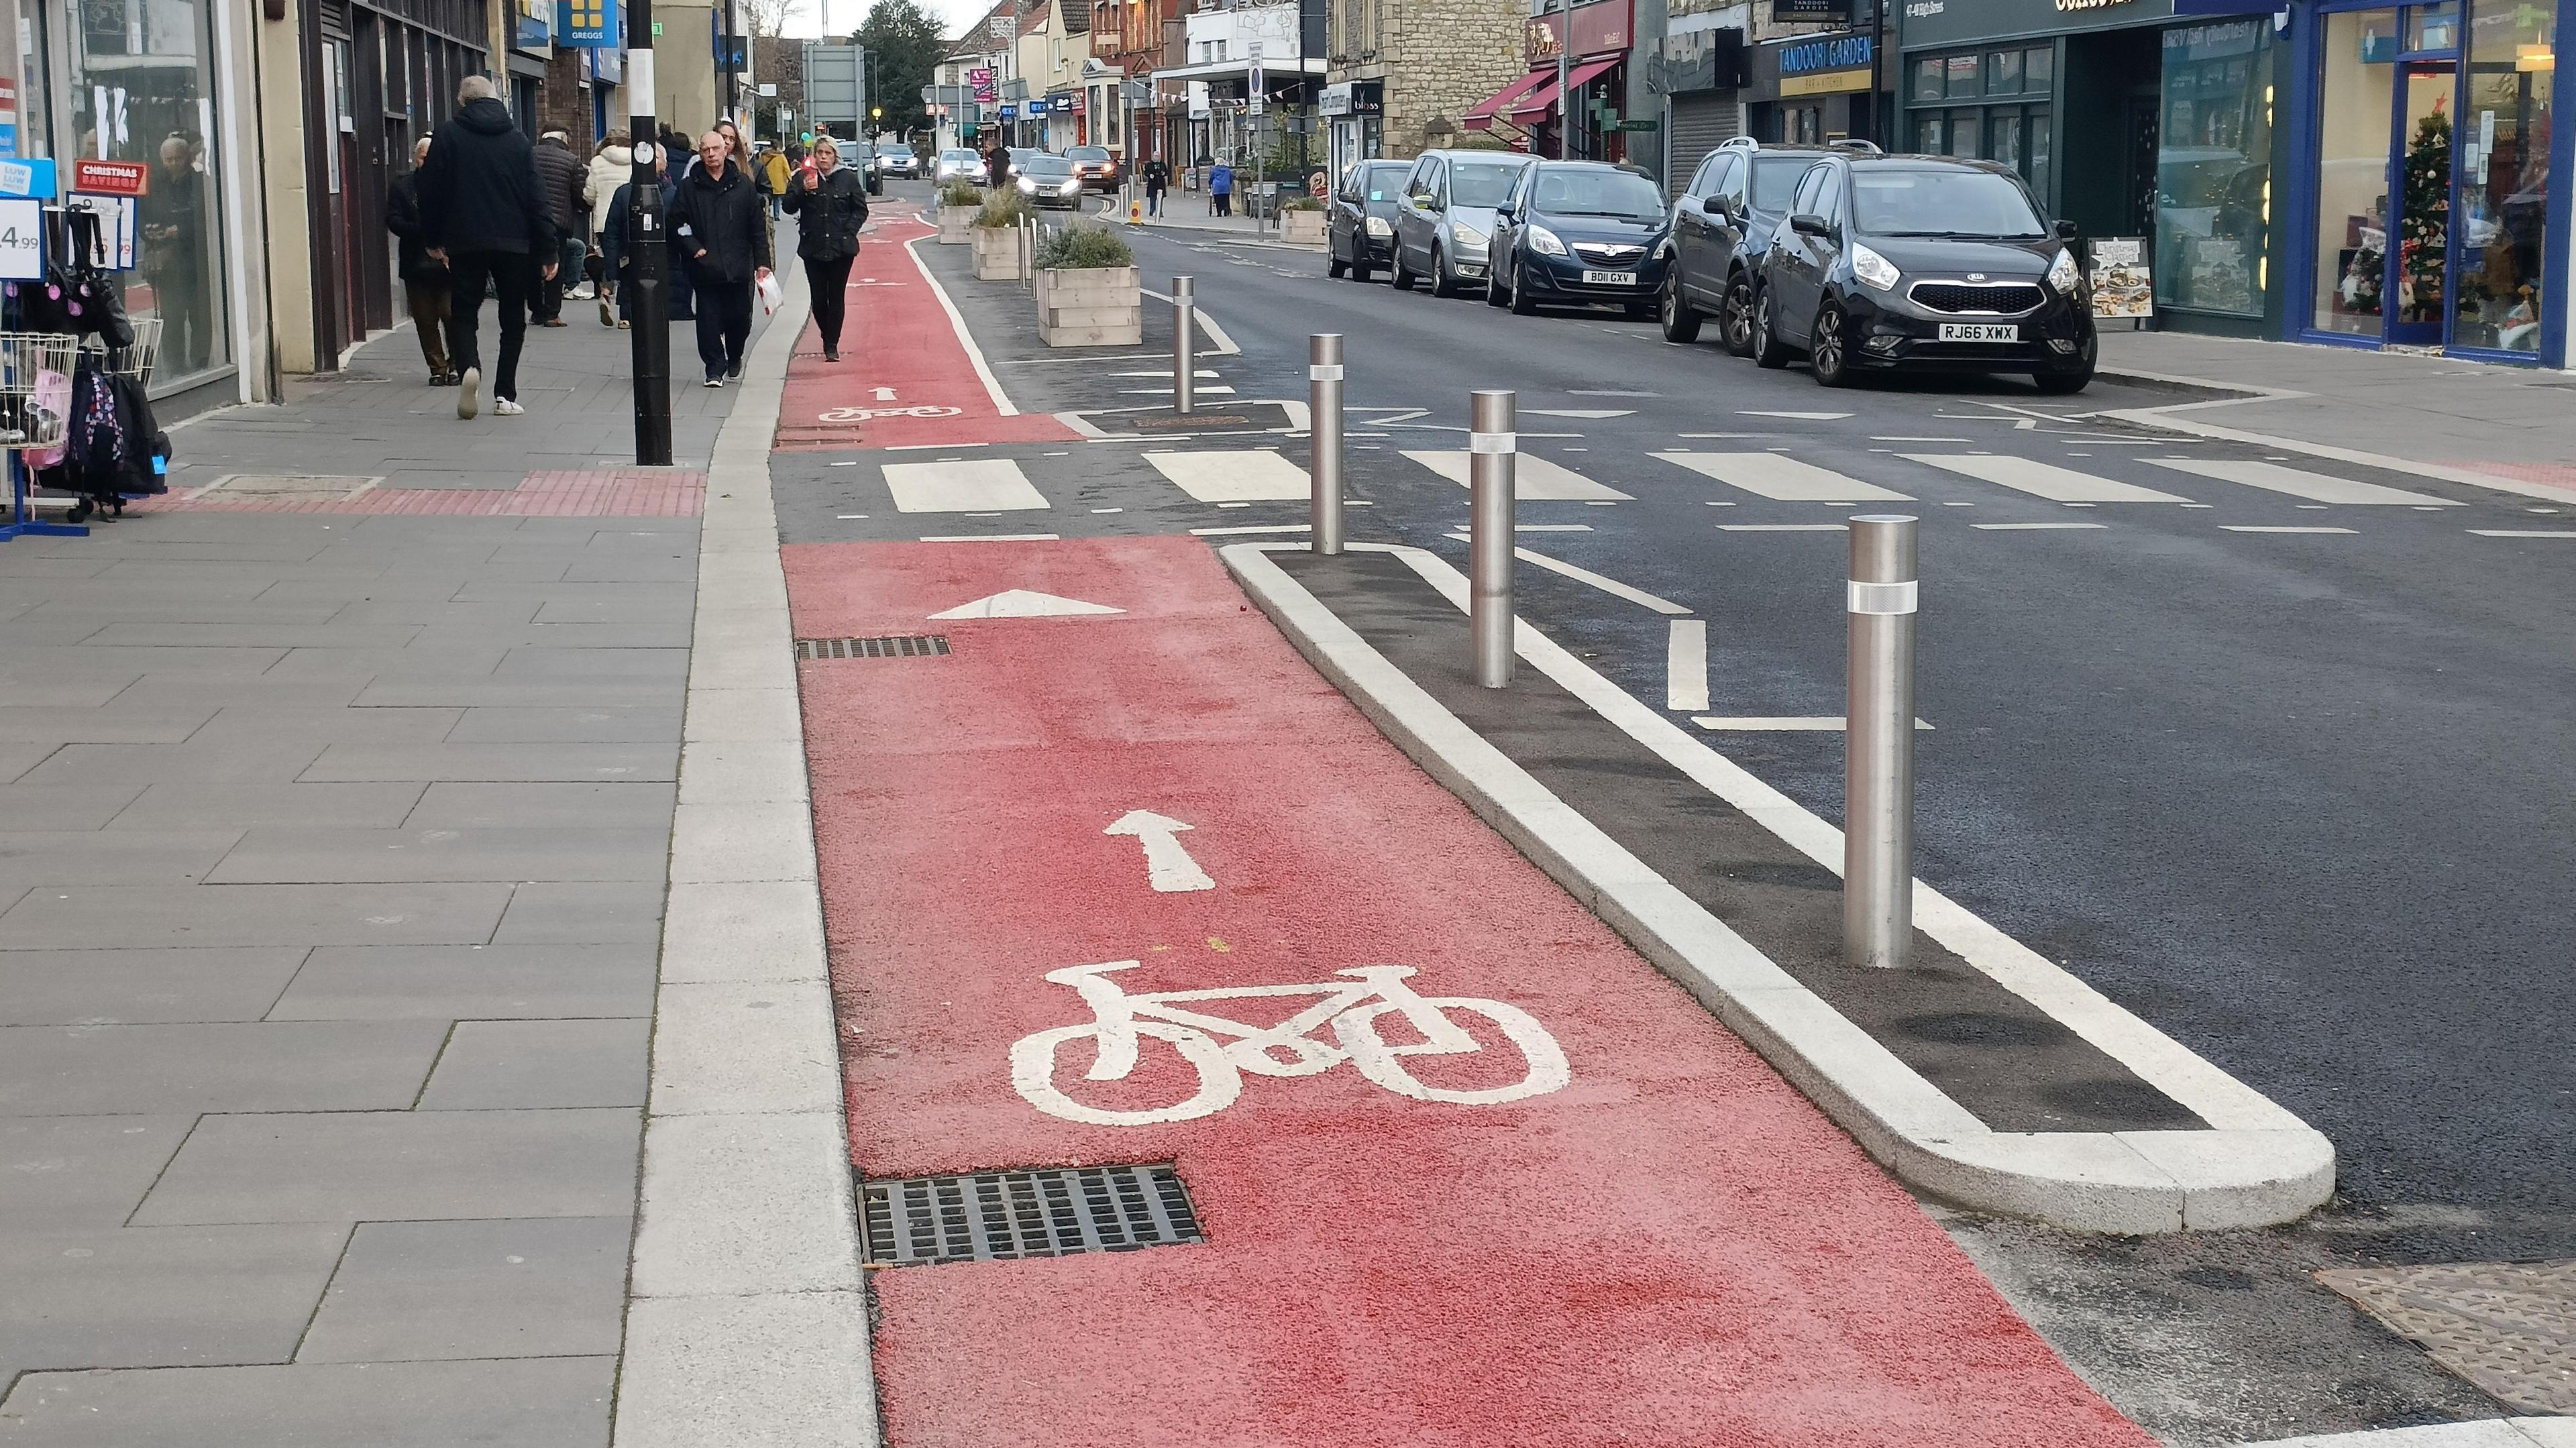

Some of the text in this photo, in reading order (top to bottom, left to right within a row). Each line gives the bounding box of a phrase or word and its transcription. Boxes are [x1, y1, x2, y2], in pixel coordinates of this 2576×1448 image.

[572, 32, 603, 40] GREGGS
[1779, 36, 1871, 73] TANDOORI GARDEN
[83, 166, 138, 178] CHRISTMAS
[82, 174, 138, 188] SAVINGS
[2097, 243, 2137, 254] Christmas
[1591, 272, 1629, 282] BD11 GXV
[1945, 326, 2012, 339] RJ66 XWX
